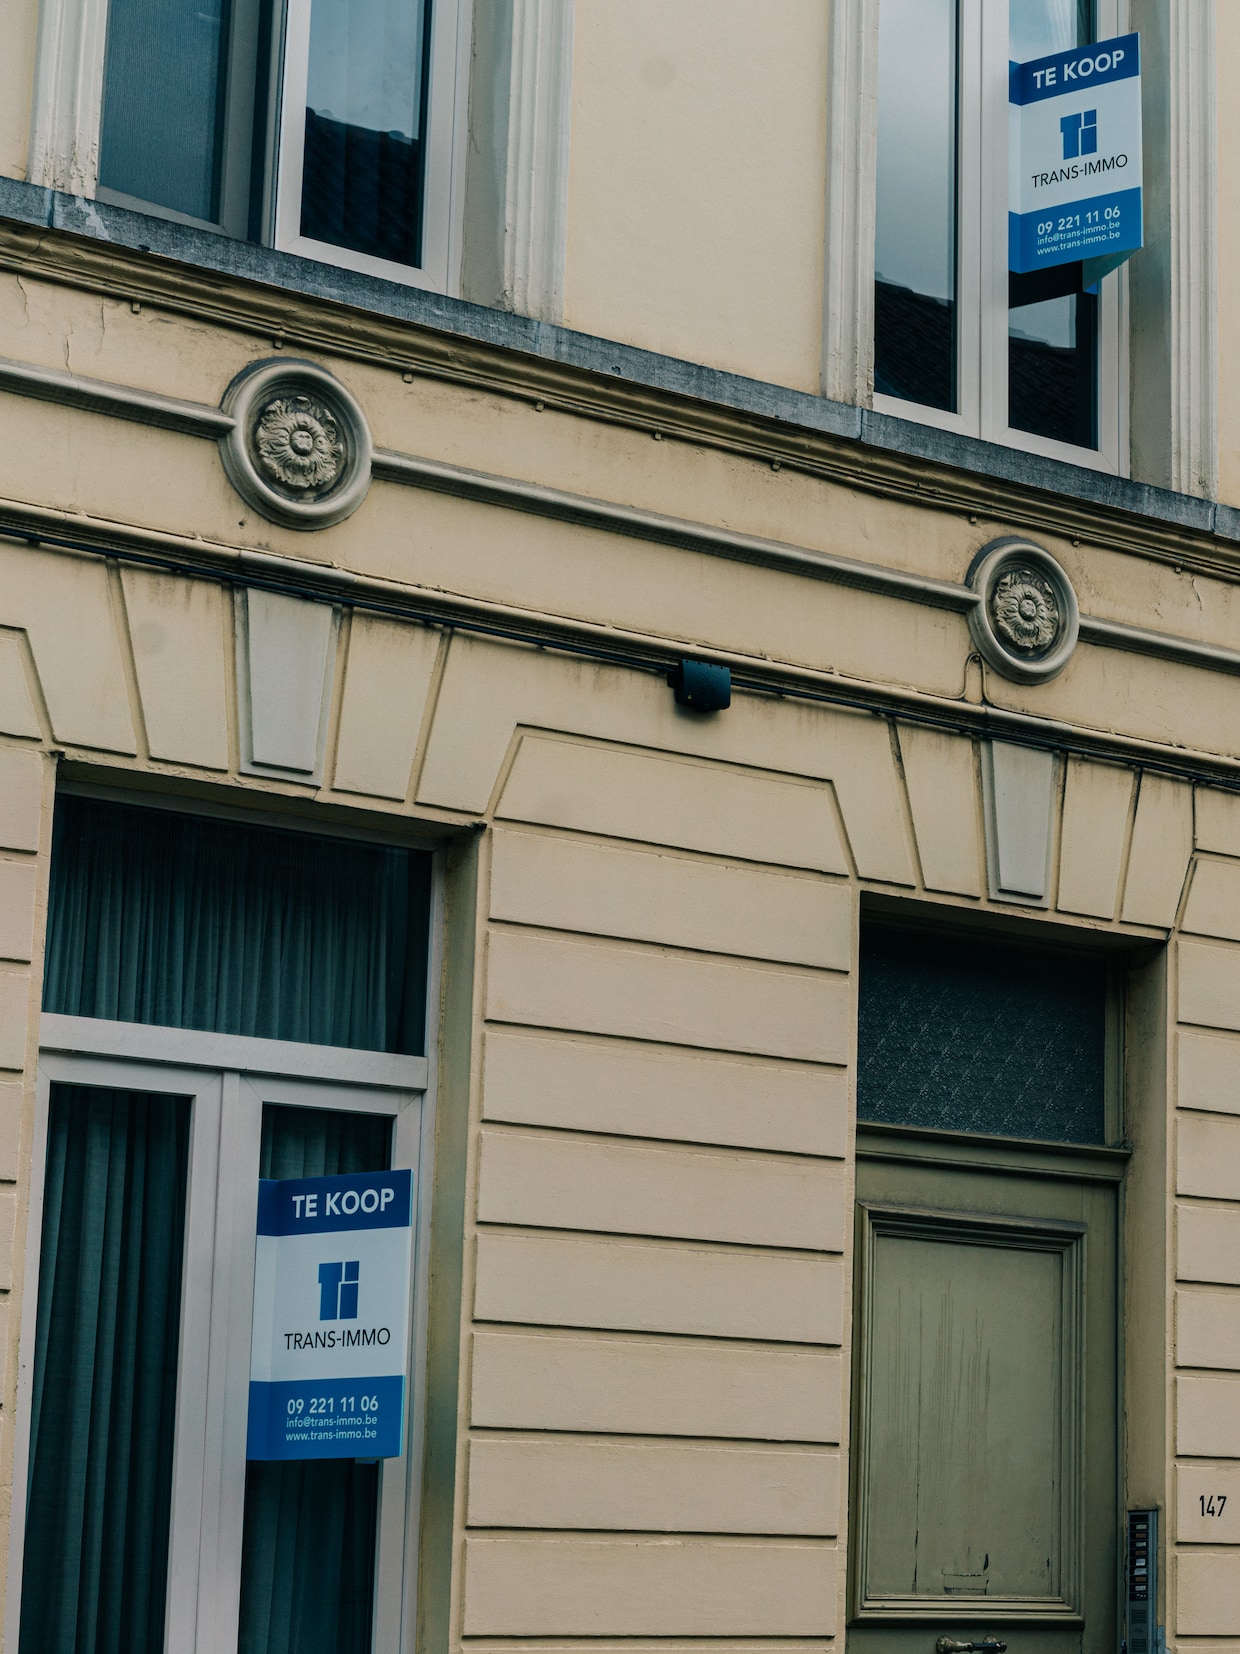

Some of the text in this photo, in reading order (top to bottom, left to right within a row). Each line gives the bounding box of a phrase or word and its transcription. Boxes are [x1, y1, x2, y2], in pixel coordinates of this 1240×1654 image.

[1033, 49, 1125, 89] TE KOOP
[1031, 154, 1128, 188] TRANS-IMMO
[1037, 206, 1120, 235] 09 221 11 06
[1037, 221, 1121, 246] info@trans-immo.be
[1037, 230, 1121, 256] www.trans-immo.be
[292, 1188, 395, 1219] TE KOOP
[284, 1327, 391, 1350] TRANS-IMMO
[287, 1395, 379, 1415] 09 221 11 06
[286, 1413, 378, 1429] info@trans-immo.be
[285, 1427, 377, 1441] www.trans-immo.be
[1199, 1495, 1227, 1517] 147
